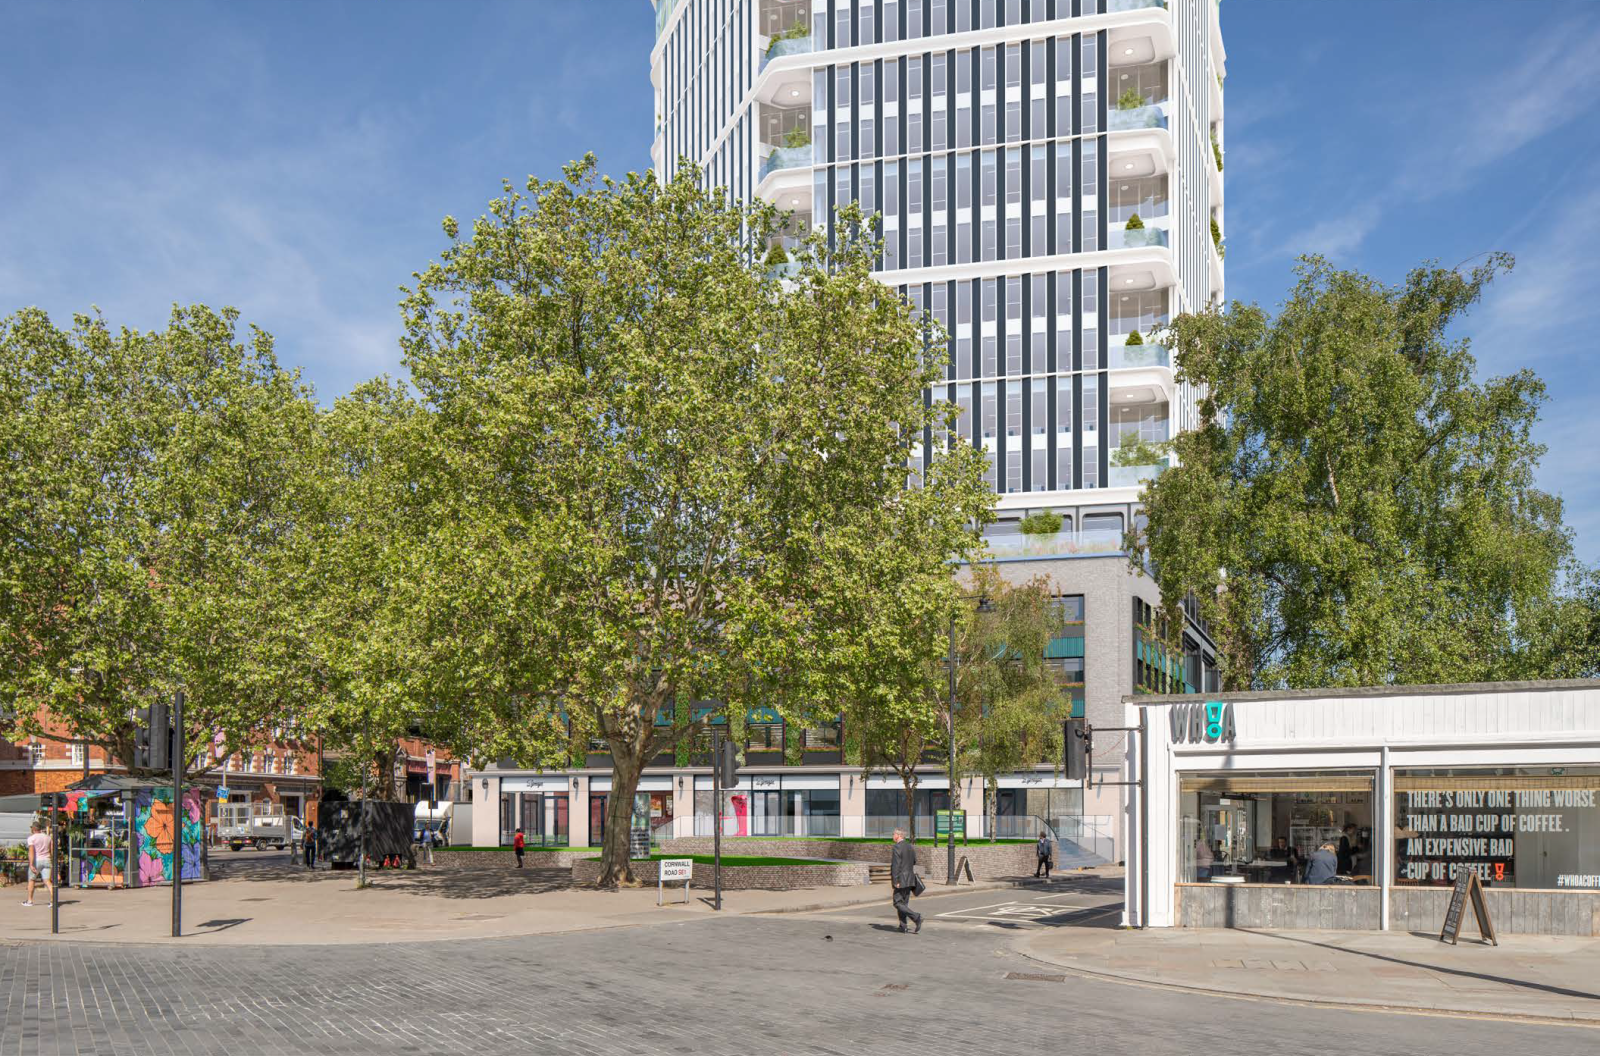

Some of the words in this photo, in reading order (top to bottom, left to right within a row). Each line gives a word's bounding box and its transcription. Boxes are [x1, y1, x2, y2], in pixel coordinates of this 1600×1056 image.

[1455, 790, 1486, 808] ONLY
[1487, 790, 1512, 808] ONE
[1514, 790, 1551, 808] THING
[1553, 790, 1596, 808] WORSE
[1407, 814, 1438, 832] THAN
[1439, 814, 1448, 832] A
[1450, 814, 1474, 832] BAD
[1475, 814, 1500, 832] CUP
[1501, 814, 1516, 832] OF
[1407, 838, 1423, 856] AN
[1425, 838, 1487, 856] EXPENSIVE
[1490, 838, 1514, 856] BAD
[1407, 862, 1431, 880] CUP
[1432, 862, 1447, 880] OF
[1449, 862, 1492, 880] CEE
